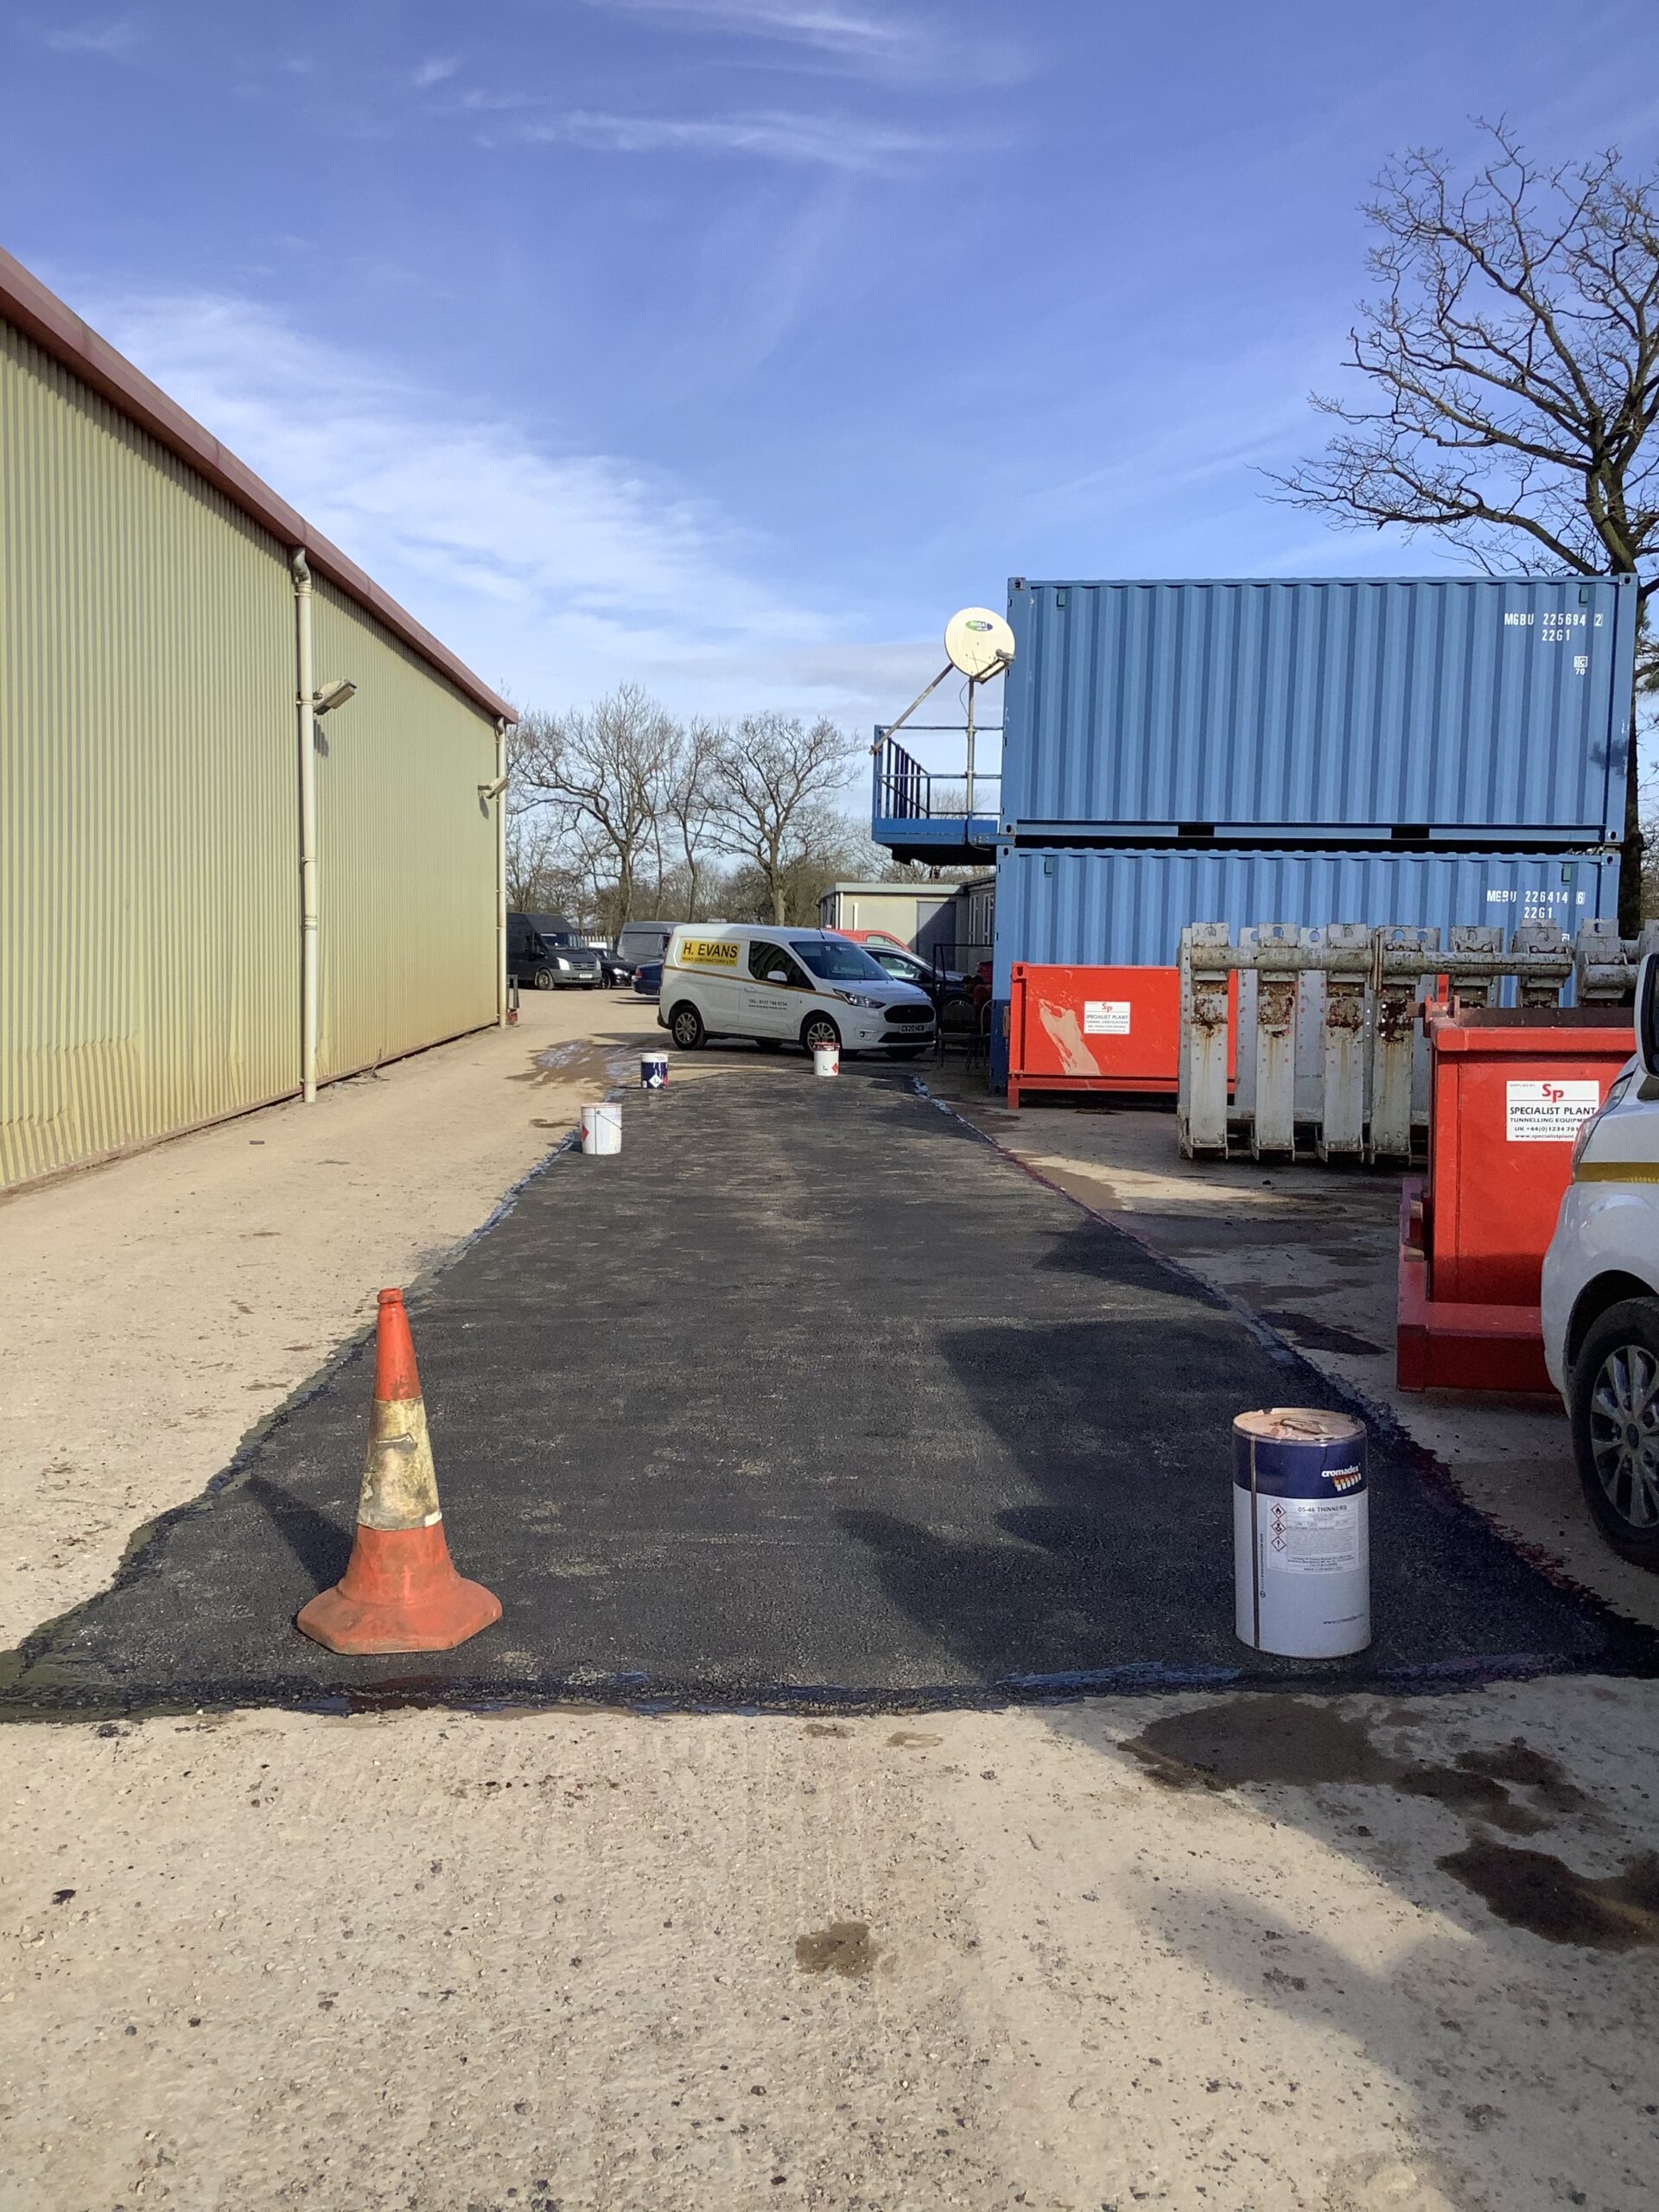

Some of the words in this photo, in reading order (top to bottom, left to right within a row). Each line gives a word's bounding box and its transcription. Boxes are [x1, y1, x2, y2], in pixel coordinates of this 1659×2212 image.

[1503, 613, 1535, 626] MGBU
[1543, 613, 1586, 626] 225694
[1594, 613, 1603, 626] 2
[1541, 629, 1570, 641] 22G1
[1525, 890, 1568, 903] 226414
[1576, 892, 1585, 905] 6
[1523, 906, 1553, 918] 22G1
[683, 943, 694, 955] H.
[697, 944, 738, 958] EVANS
[1321, 1465, 1359, 1478] cromadex
